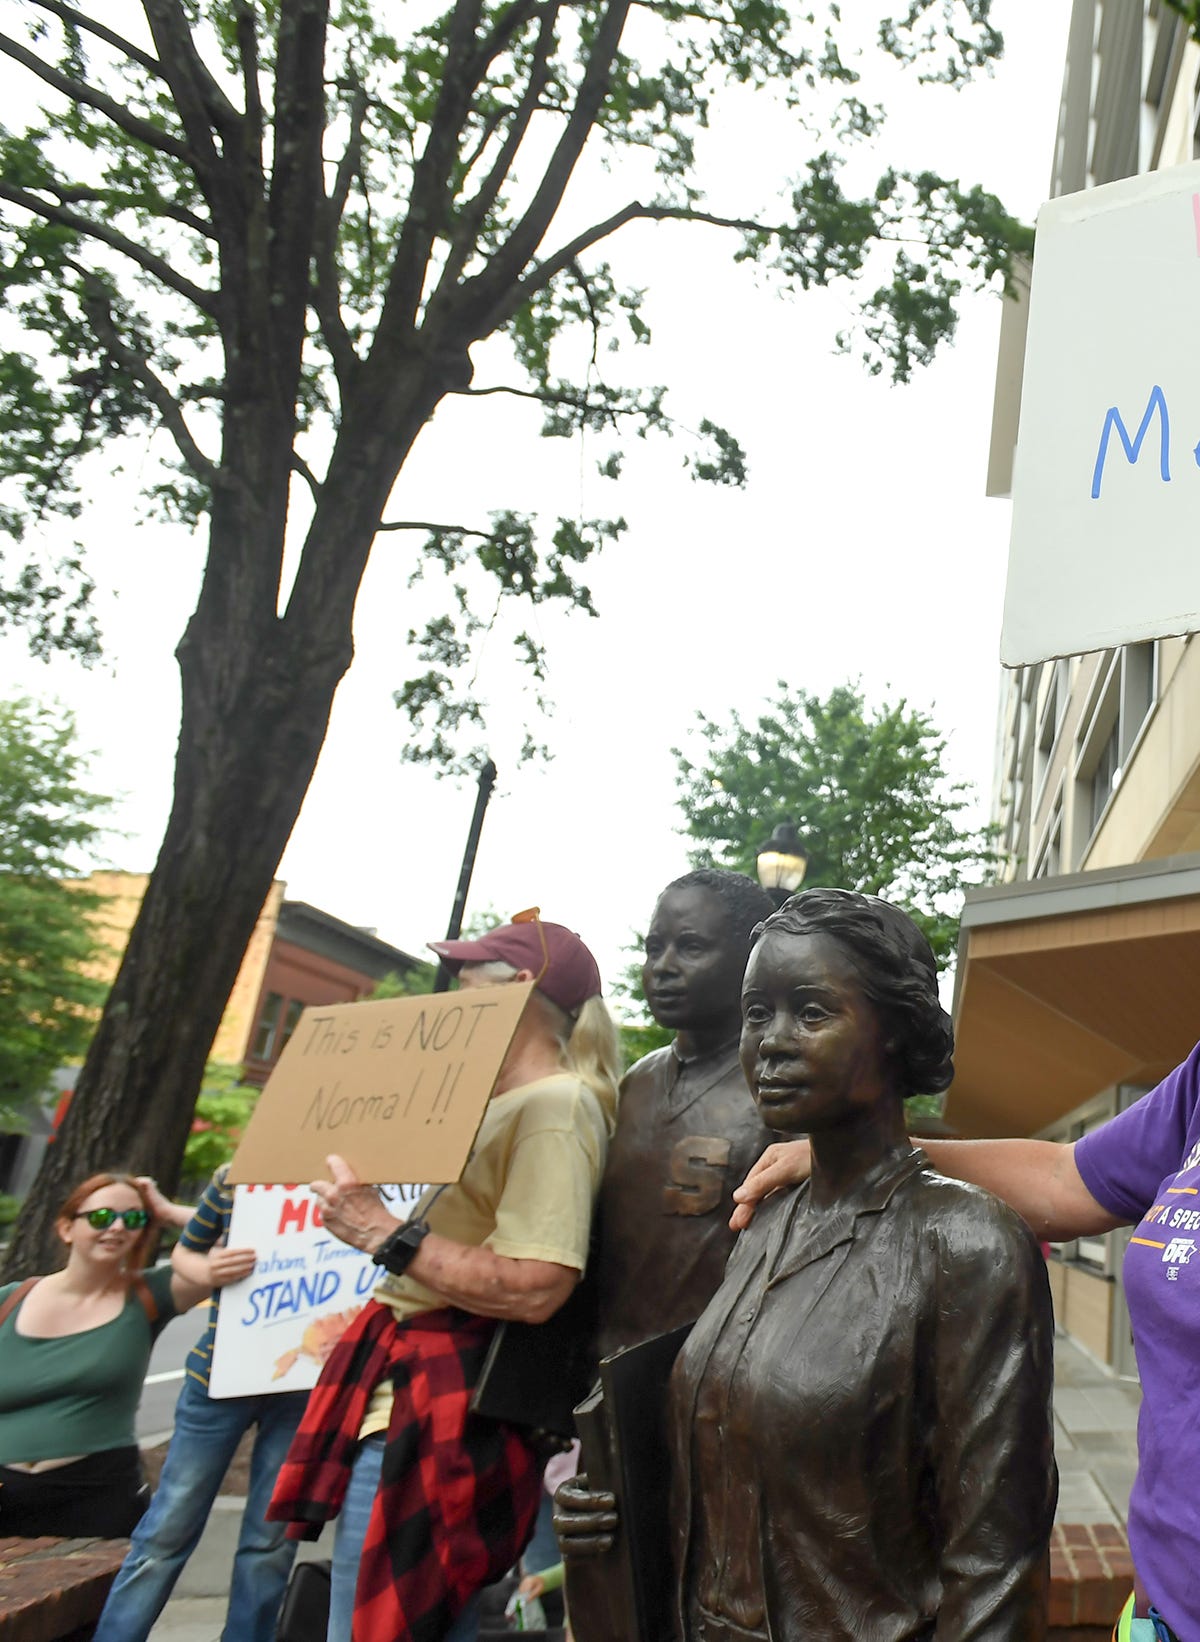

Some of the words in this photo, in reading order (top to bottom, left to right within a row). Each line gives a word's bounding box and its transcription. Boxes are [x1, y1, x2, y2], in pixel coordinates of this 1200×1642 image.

[303, 1016, 360, 1056] This
[371, 1019, 394, 1049] is
[403, 1003, 498, 1051] NOT
[301, 1068, 424, 1131] Normal
[663, 1136, 732, 1216] S
[1157, 1205, 1173, 1225] A
[242, 1270, 340, 1327] STAND
